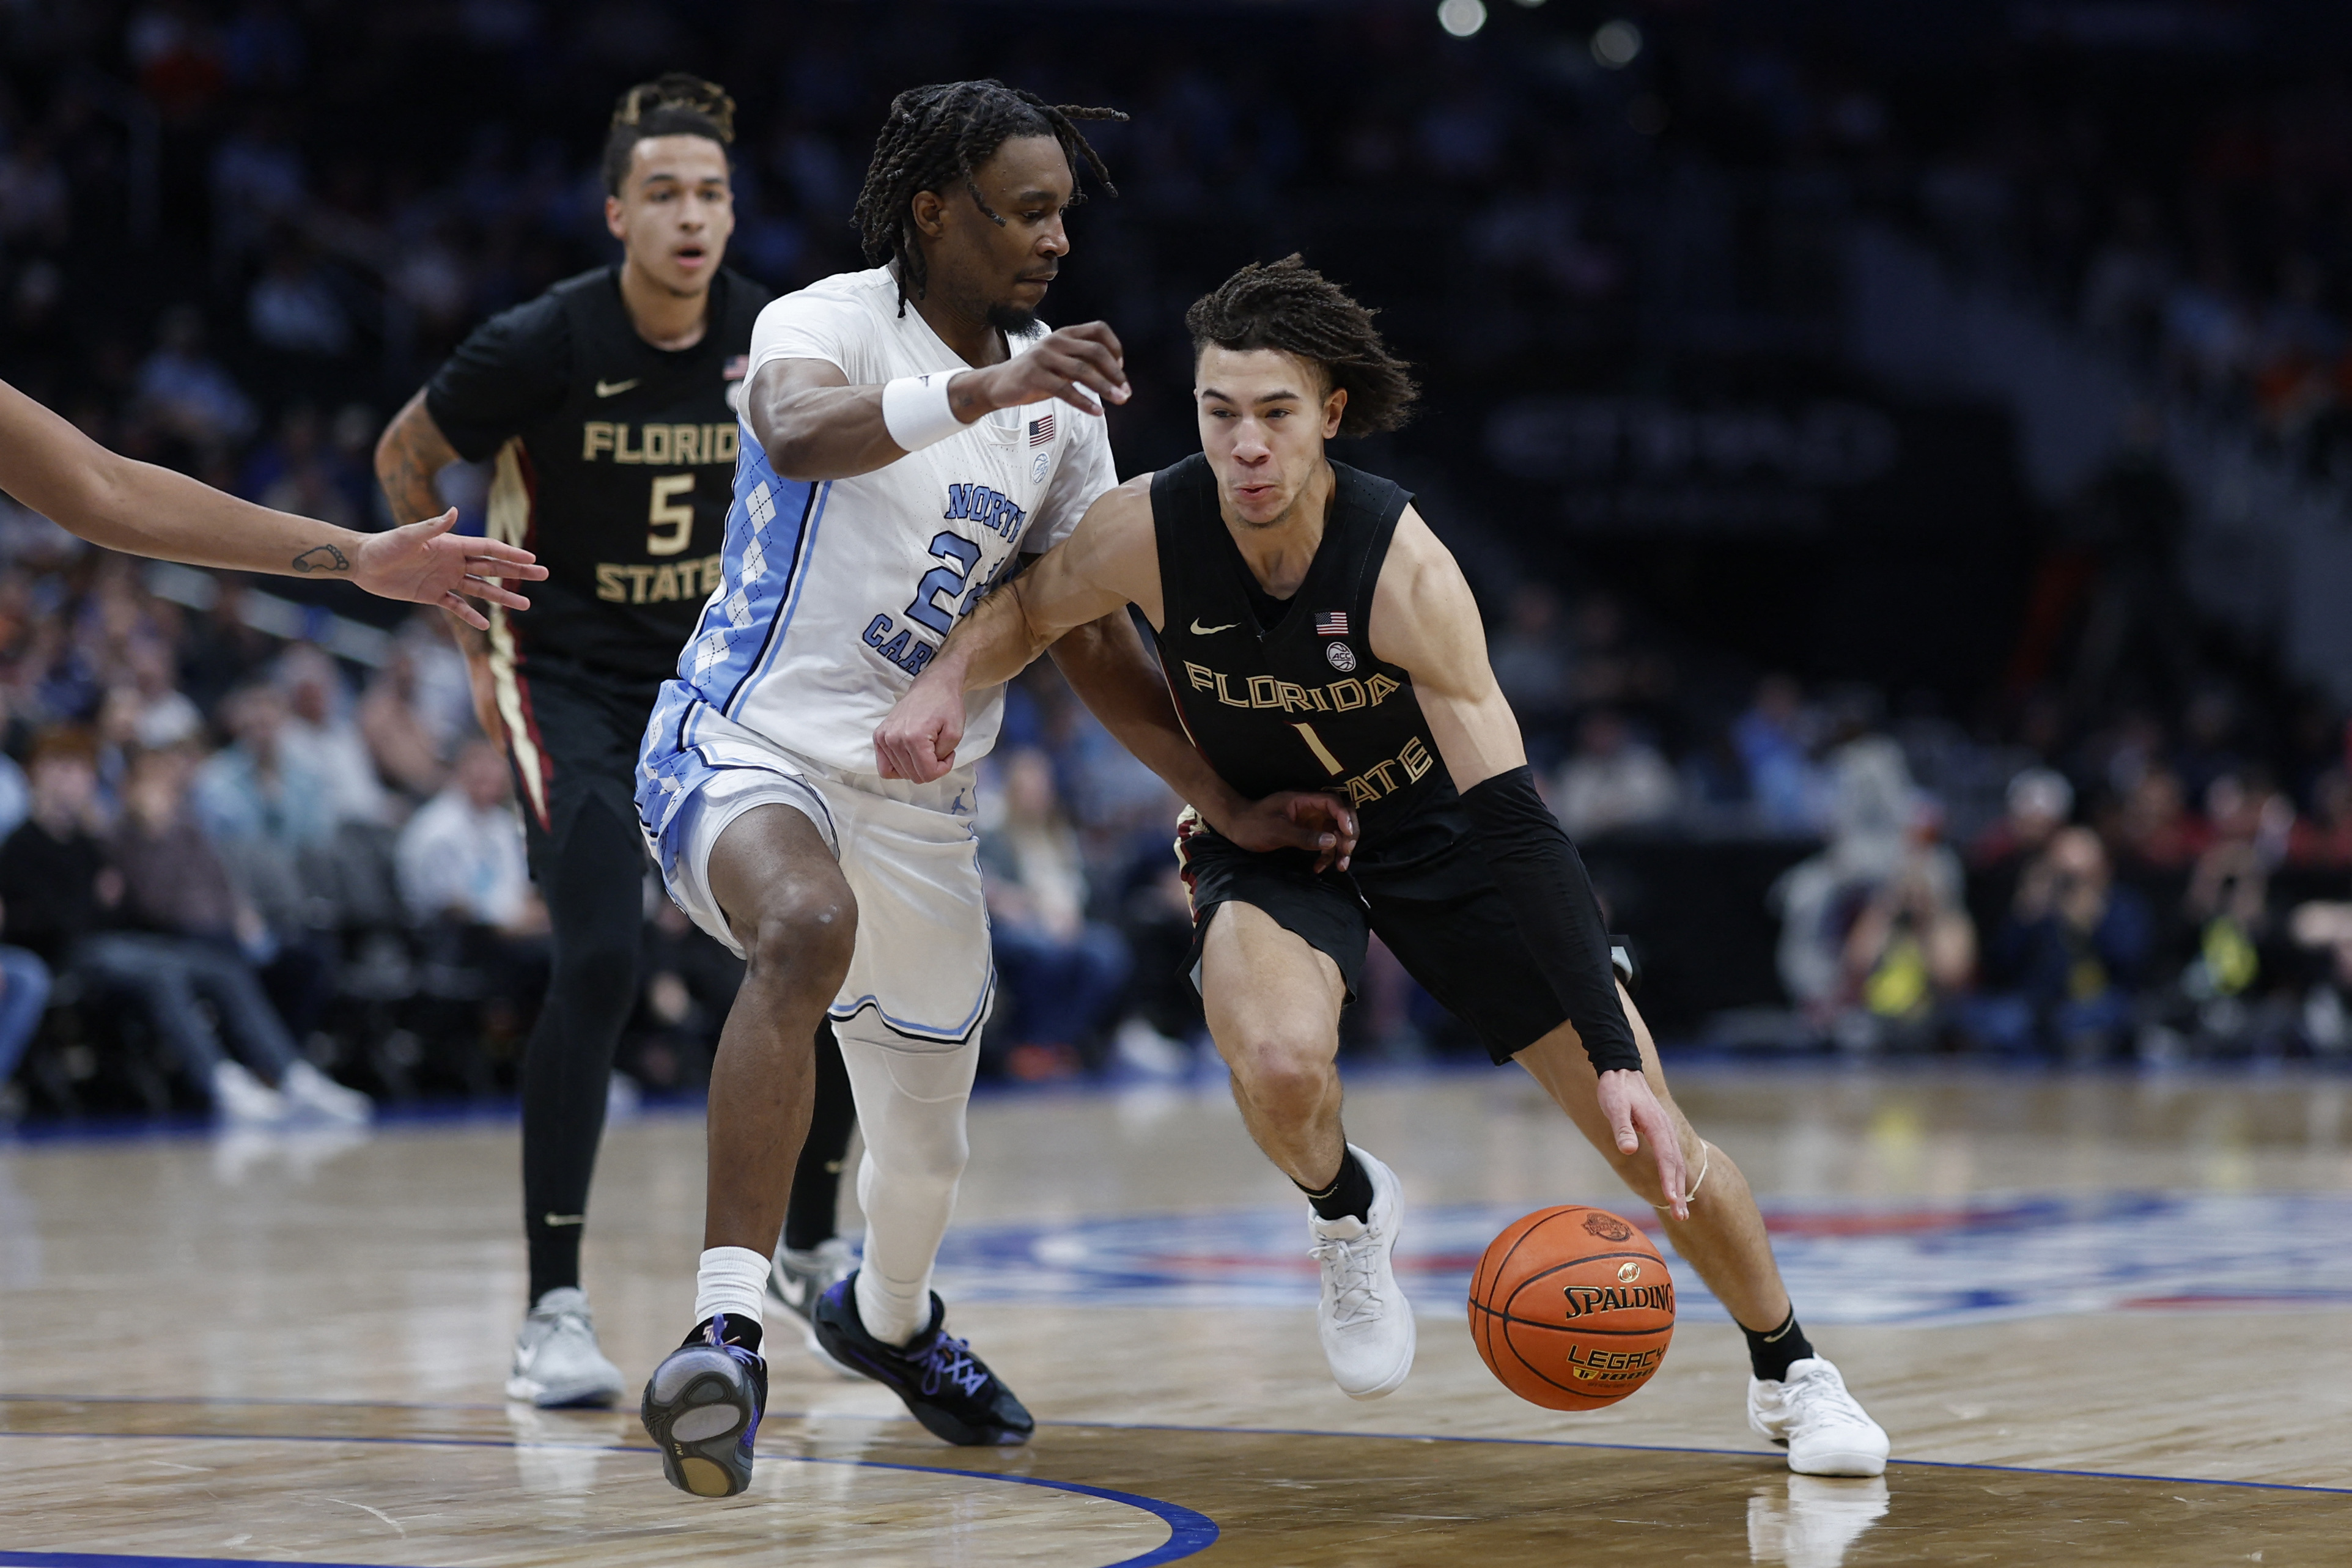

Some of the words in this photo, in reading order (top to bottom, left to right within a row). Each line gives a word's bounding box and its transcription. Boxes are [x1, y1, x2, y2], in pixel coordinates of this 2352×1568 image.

[582, 421, 739, 465] FLORID
[647, 473, 695, 555] 5
[863, 613, 937, 677] CAR
[1183, 660, 1400, 713] FLORIDA
[1288, 722, 1344, 777] 1
[1321, 736, 1434, 809] ATE
[1563, 1283, 1673, 1320] SPALDING
[1566, 1343, 1667, 1370] LEGACY
